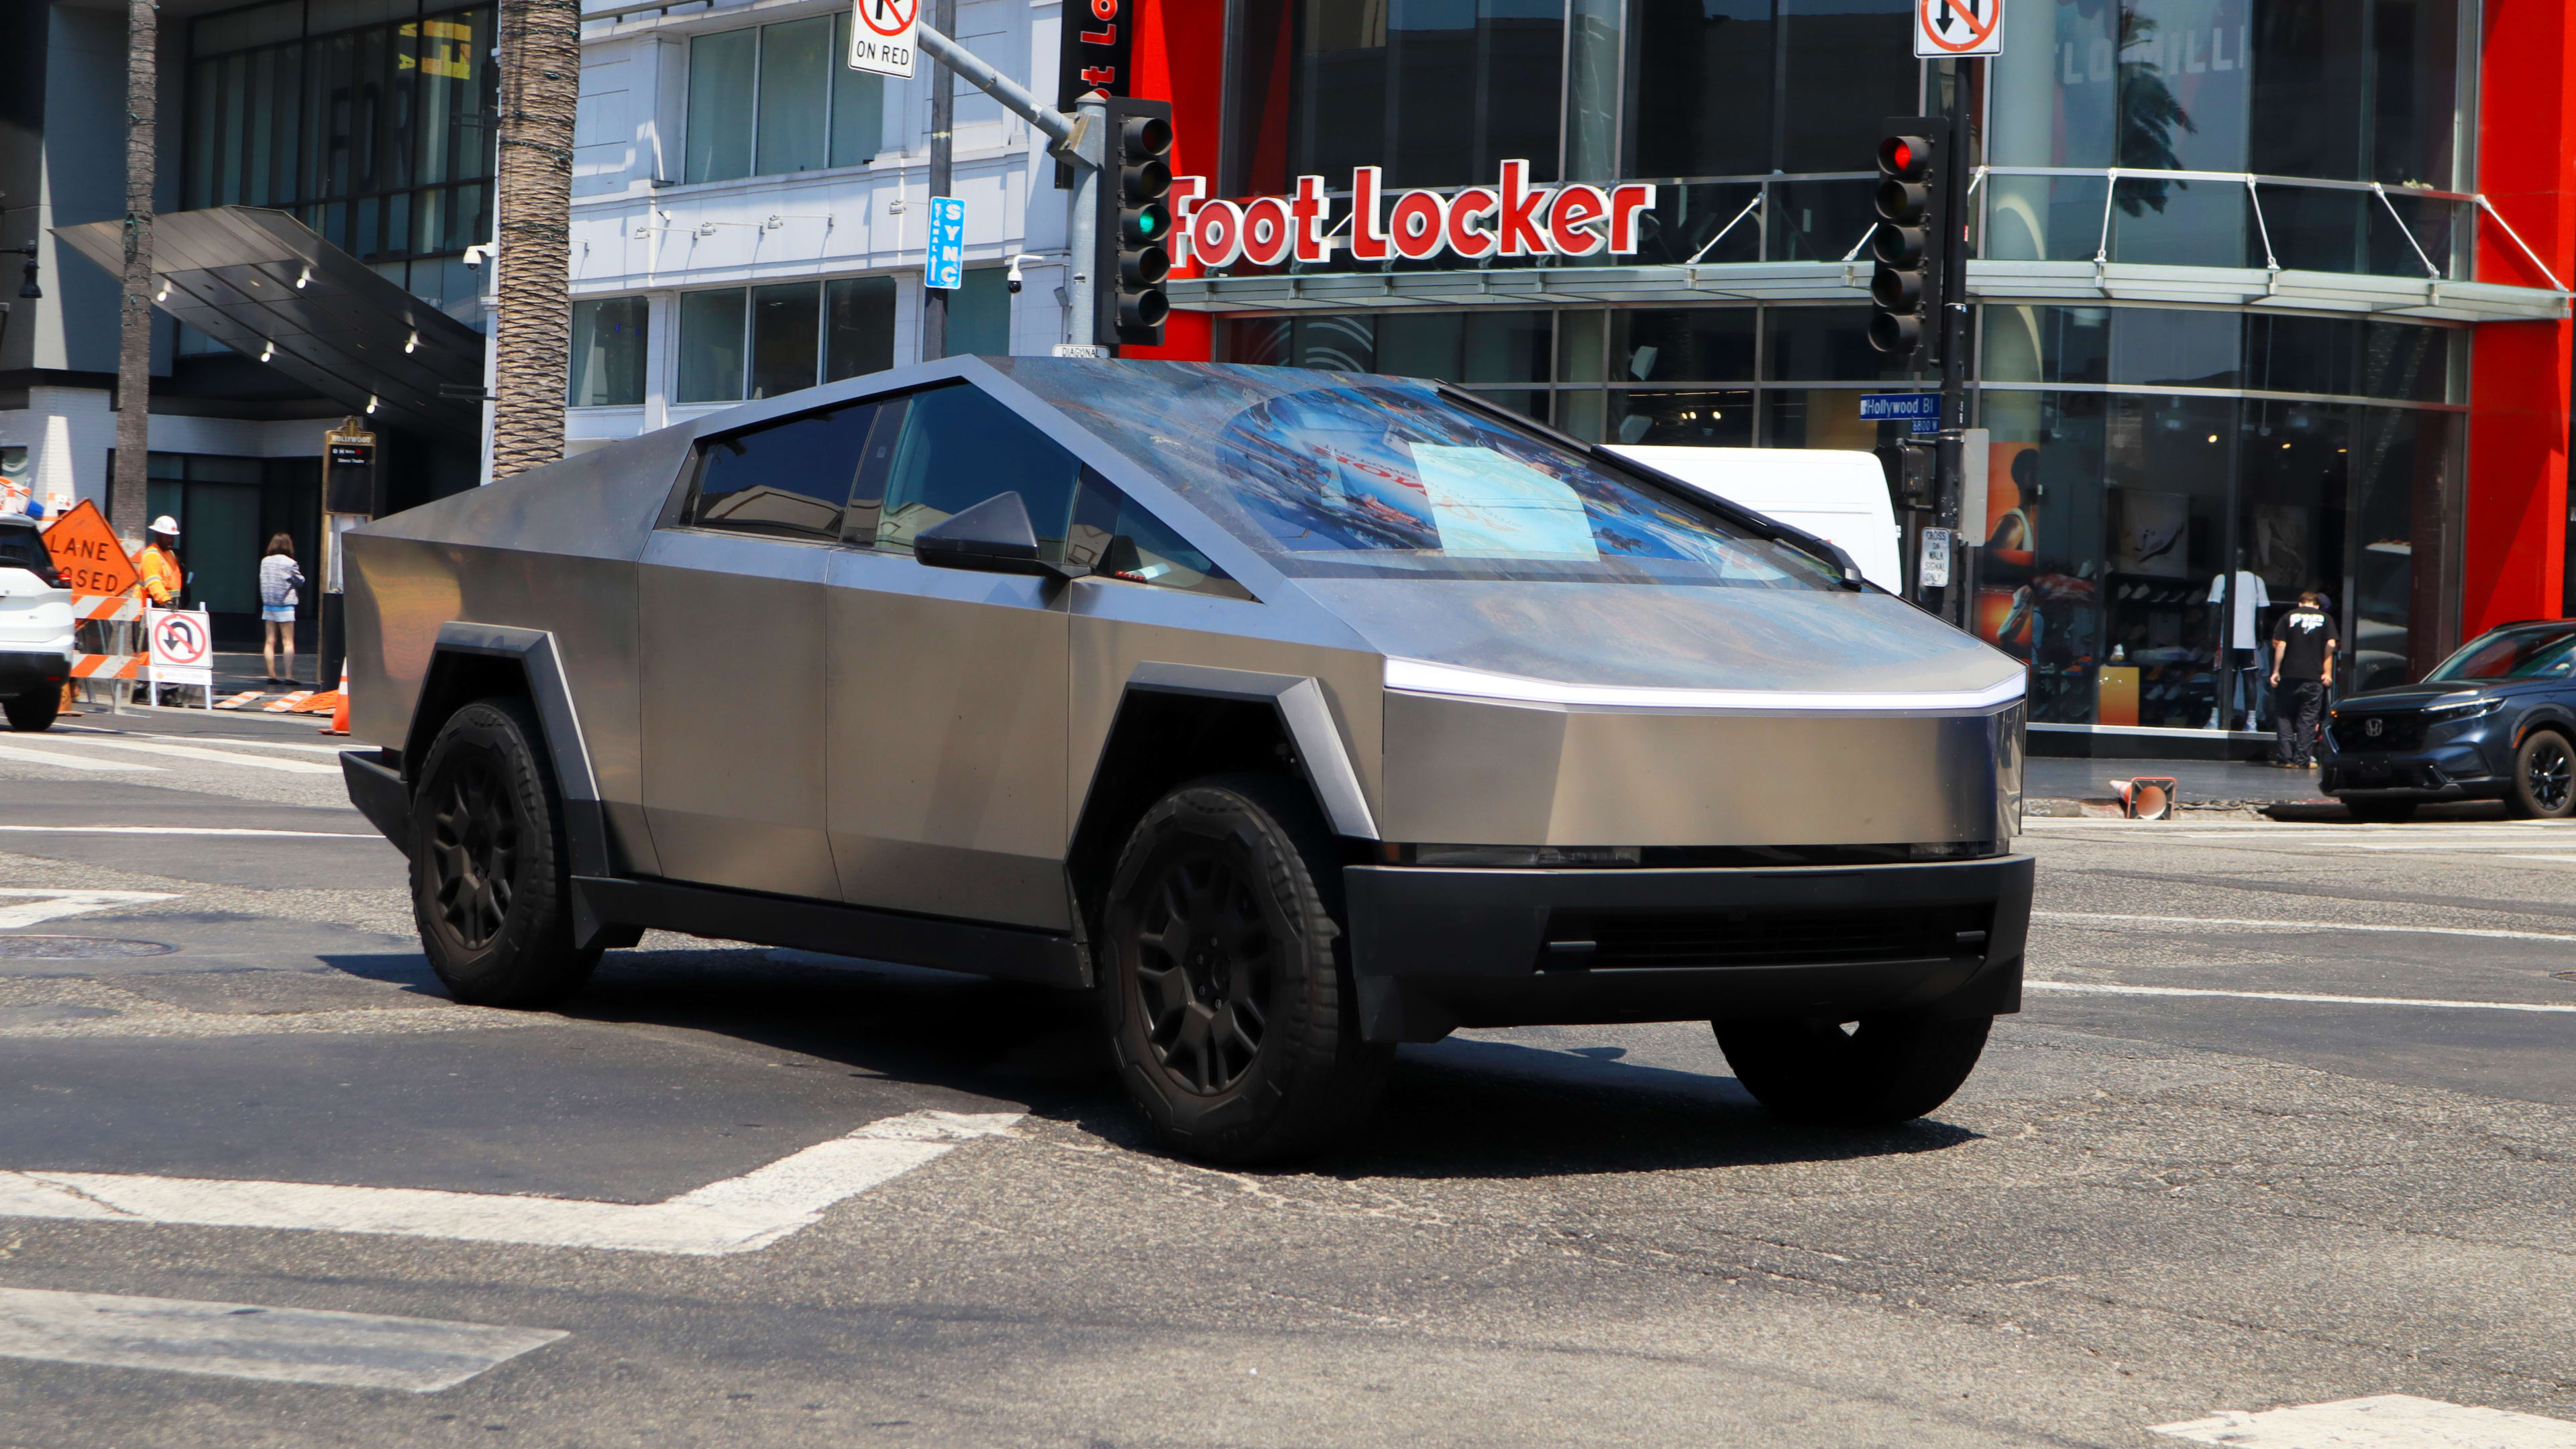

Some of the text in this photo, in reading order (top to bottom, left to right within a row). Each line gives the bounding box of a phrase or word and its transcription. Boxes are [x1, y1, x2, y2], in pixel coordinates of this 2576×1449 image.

[857, 40, 909, 66] ON RED
[1168, 158, 1656, 268] Foot Locker
[941, 204, 961, 282] SYNC
[1062, 347, 1100, 358] DIAGONAL
[1867, 398, 1933, 418] Hollywood Bl
[50, 535, 109, 561] LANE
[1926, 531, 1946, 541] CROSS
[60, 567, 118, 592] OSED
